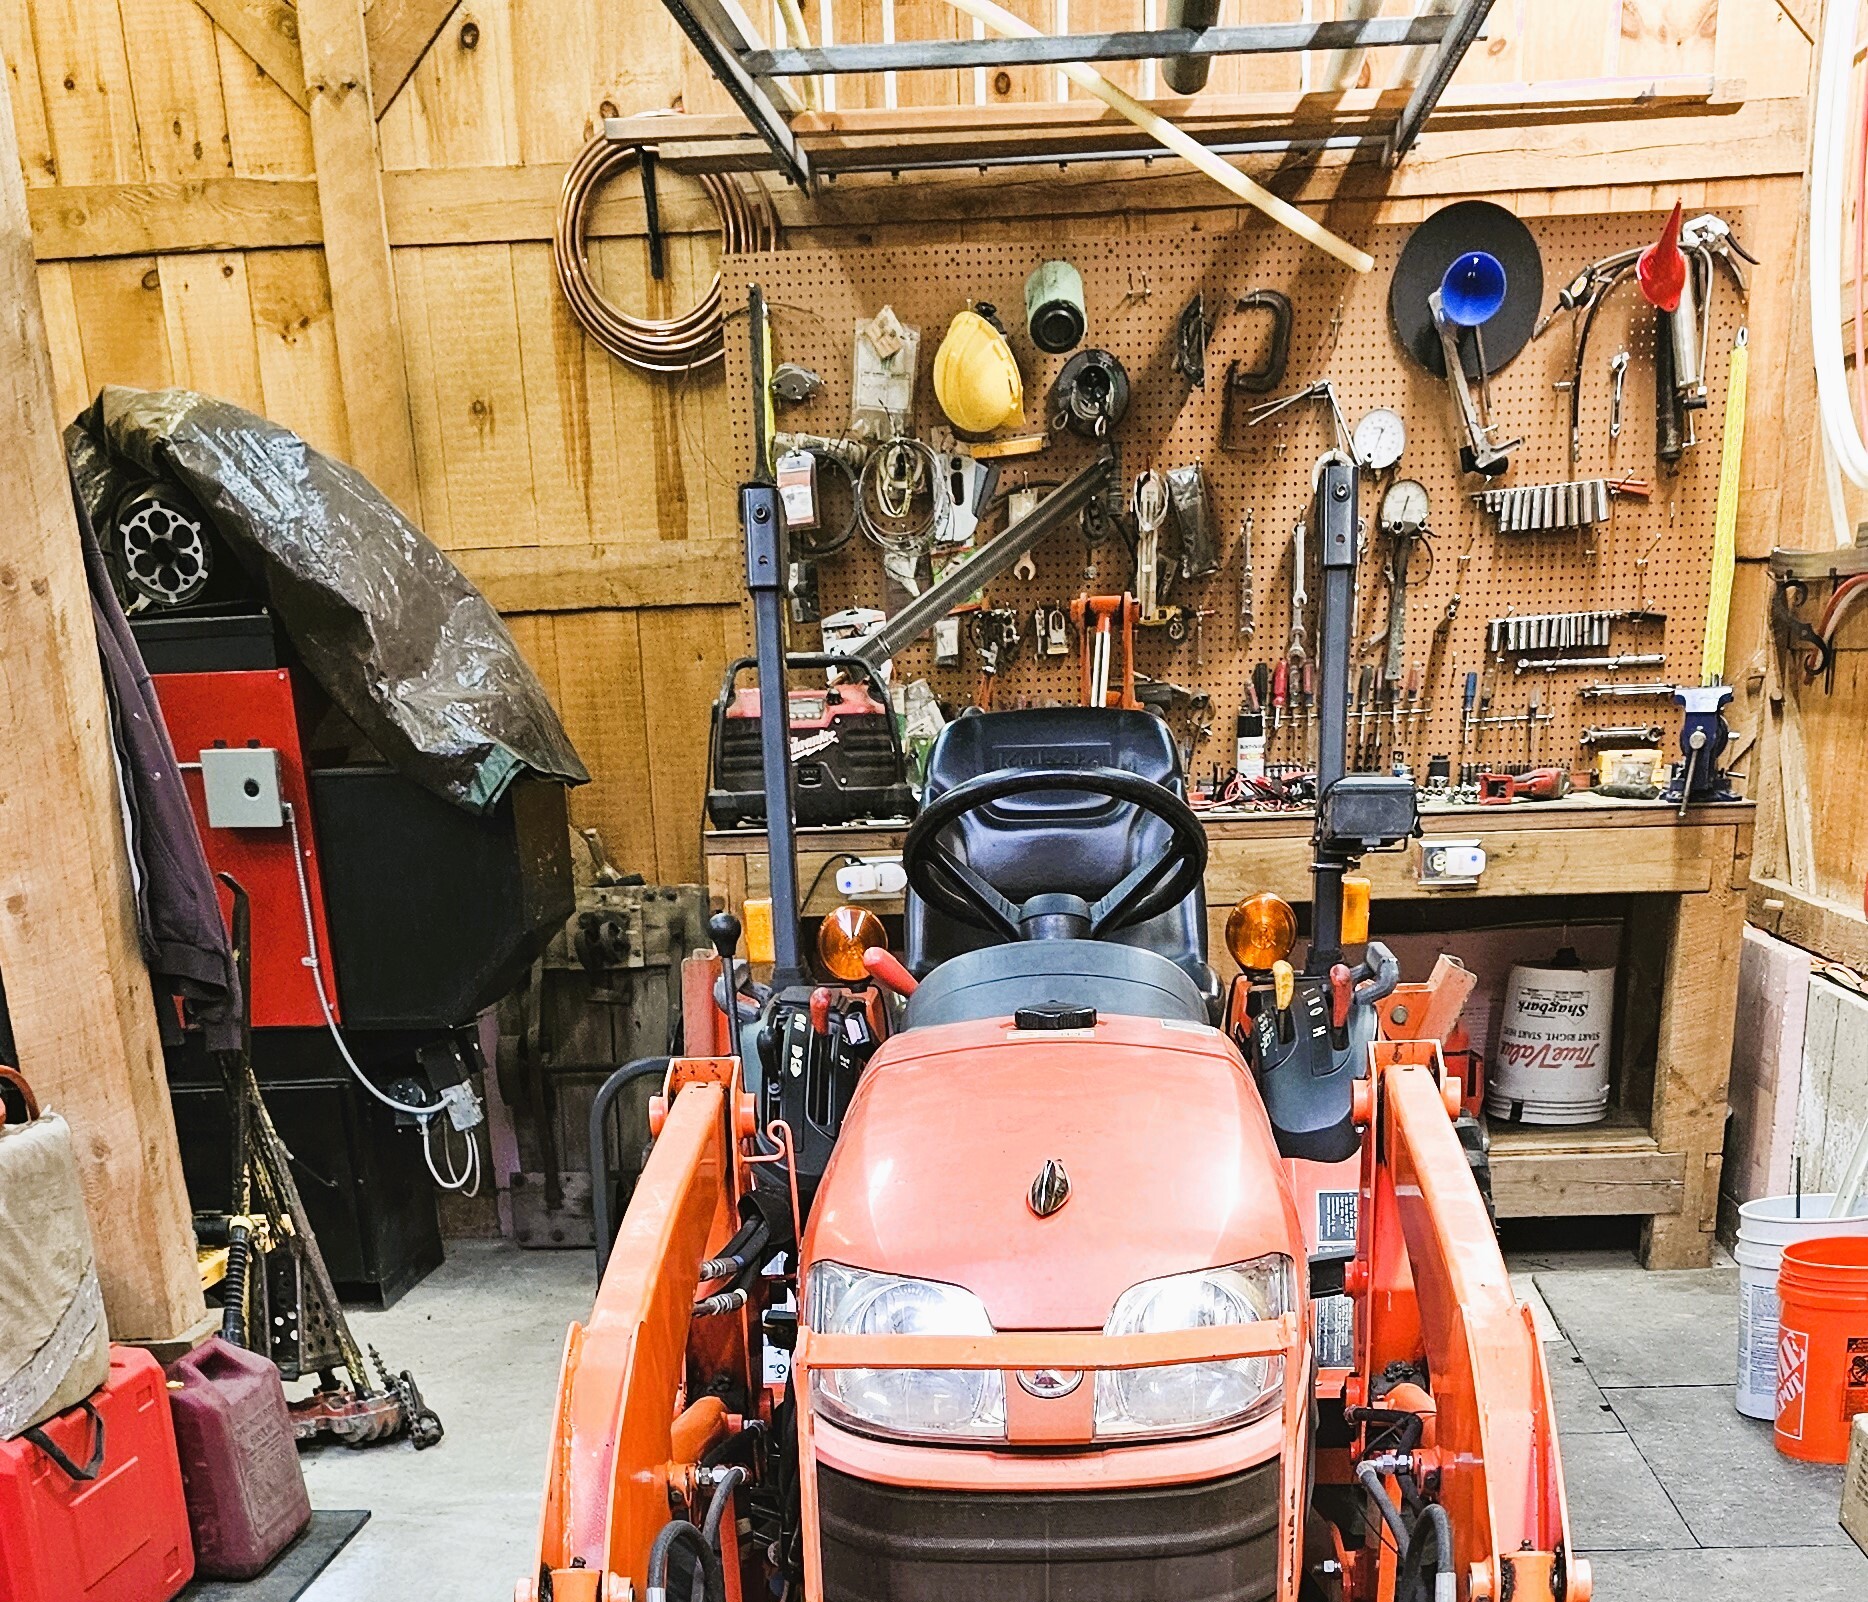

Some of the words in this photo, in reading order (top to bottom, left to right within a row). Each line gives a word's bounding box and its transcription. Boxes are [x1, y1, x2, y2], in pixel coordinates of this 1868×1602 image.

[1517, 999, 1589, 1017] Shagbark
[1517, 1029, 1542, 1041] START
[1577, 1031, 1601, 1042] START
